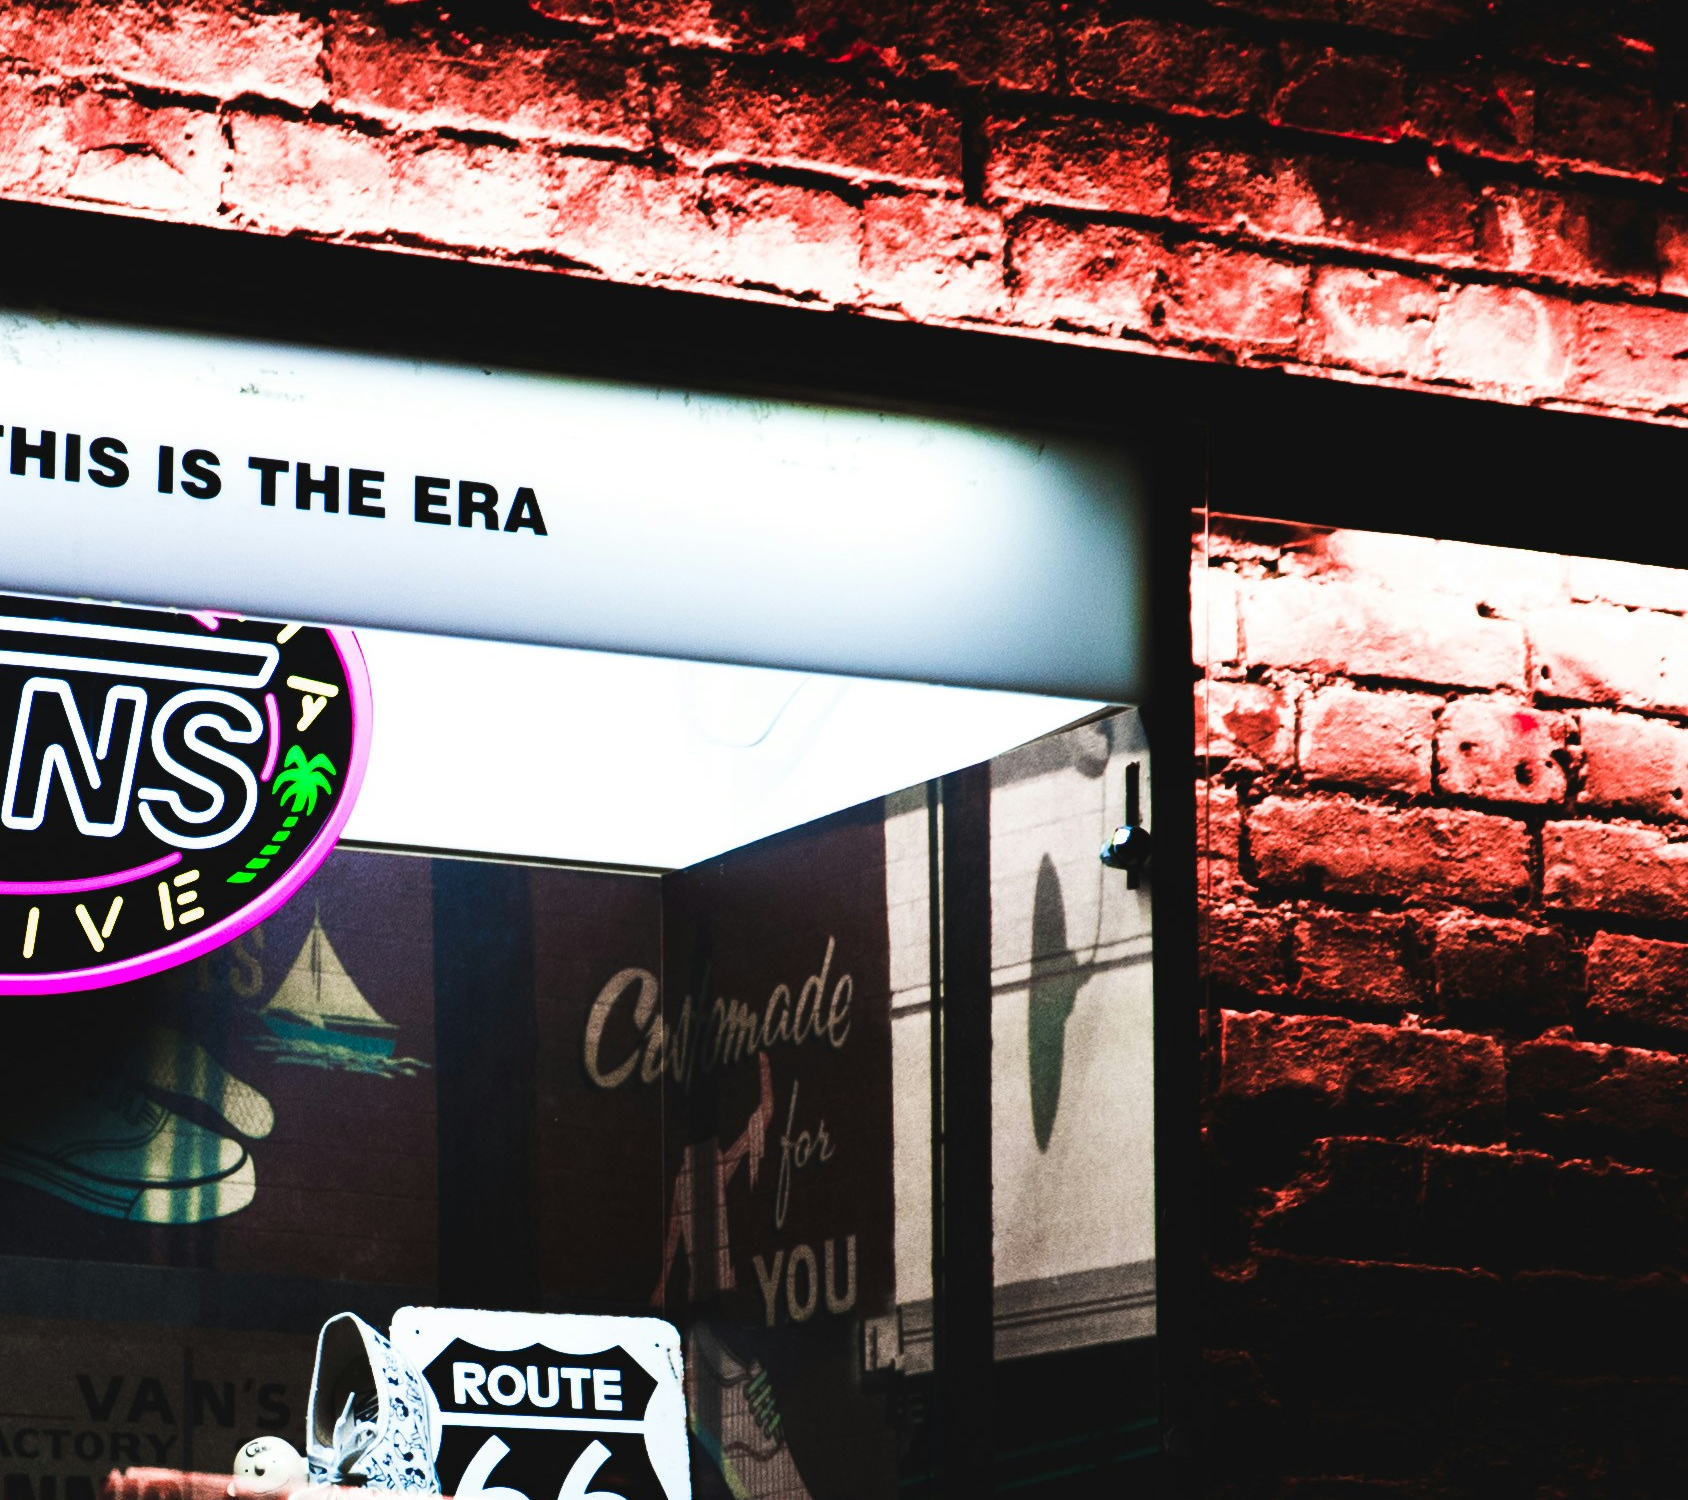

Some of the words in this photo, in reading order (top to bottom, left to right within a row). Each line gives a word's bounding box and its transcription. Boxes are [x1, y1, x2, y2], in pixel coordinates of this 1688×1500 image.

[158, 445, 223, 500] IS
[249, 456, 387, 518] THE
[414, 474, 549, 537] ERA
[773, 1079, 837, 1229] for
[752, 1234, 859, 1329] YOU
[75, 1373, 291, 1431] VAN'S
[452, 1360, 624, 1413] ROUTE
